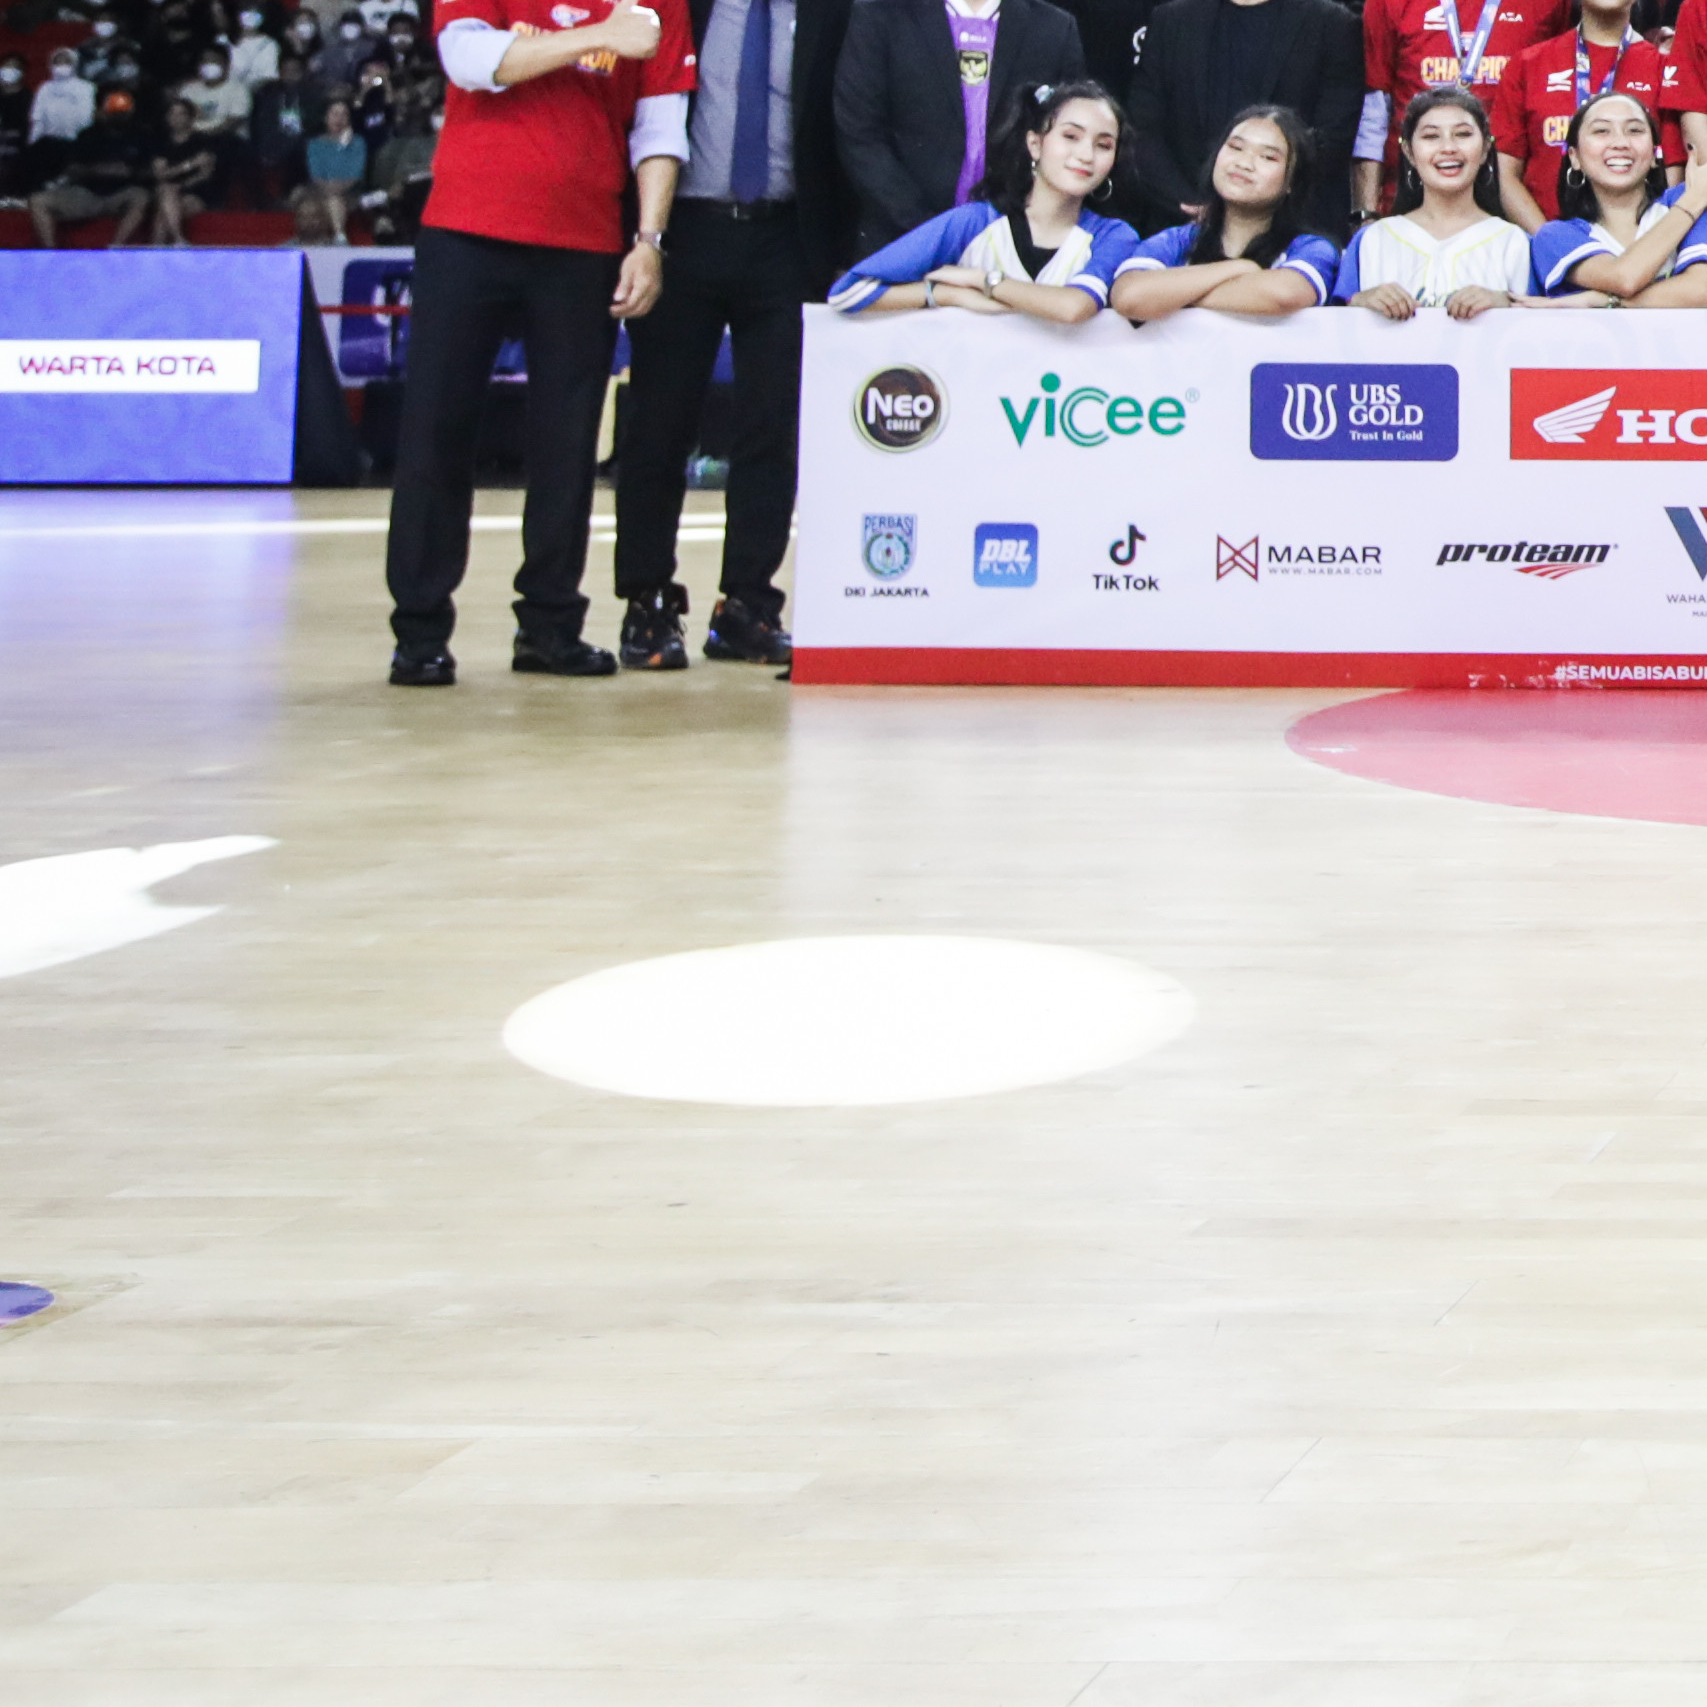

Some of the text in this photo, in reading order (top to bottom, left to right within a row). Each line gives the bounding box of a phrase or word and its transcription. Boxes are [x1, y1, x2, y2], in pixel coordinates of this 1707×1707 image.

[19, 356, 216, 376] WARTA KOTA
[1350, 384, 1401, 405] UBS
[866, 387, 934, 424] NEO
[1349, 405, 1424, 425] GOLD
[1350, 430, 1423, 441] Trust In Gold
[982, 539, 1032, 562] DBL
[1268, 546, 1381, 563] MABAR
[1436, 541, 1610, 566] proteam
[979, 562, 1031, 574] PLAY
[871, 587, 929, 597] JAKARTA
